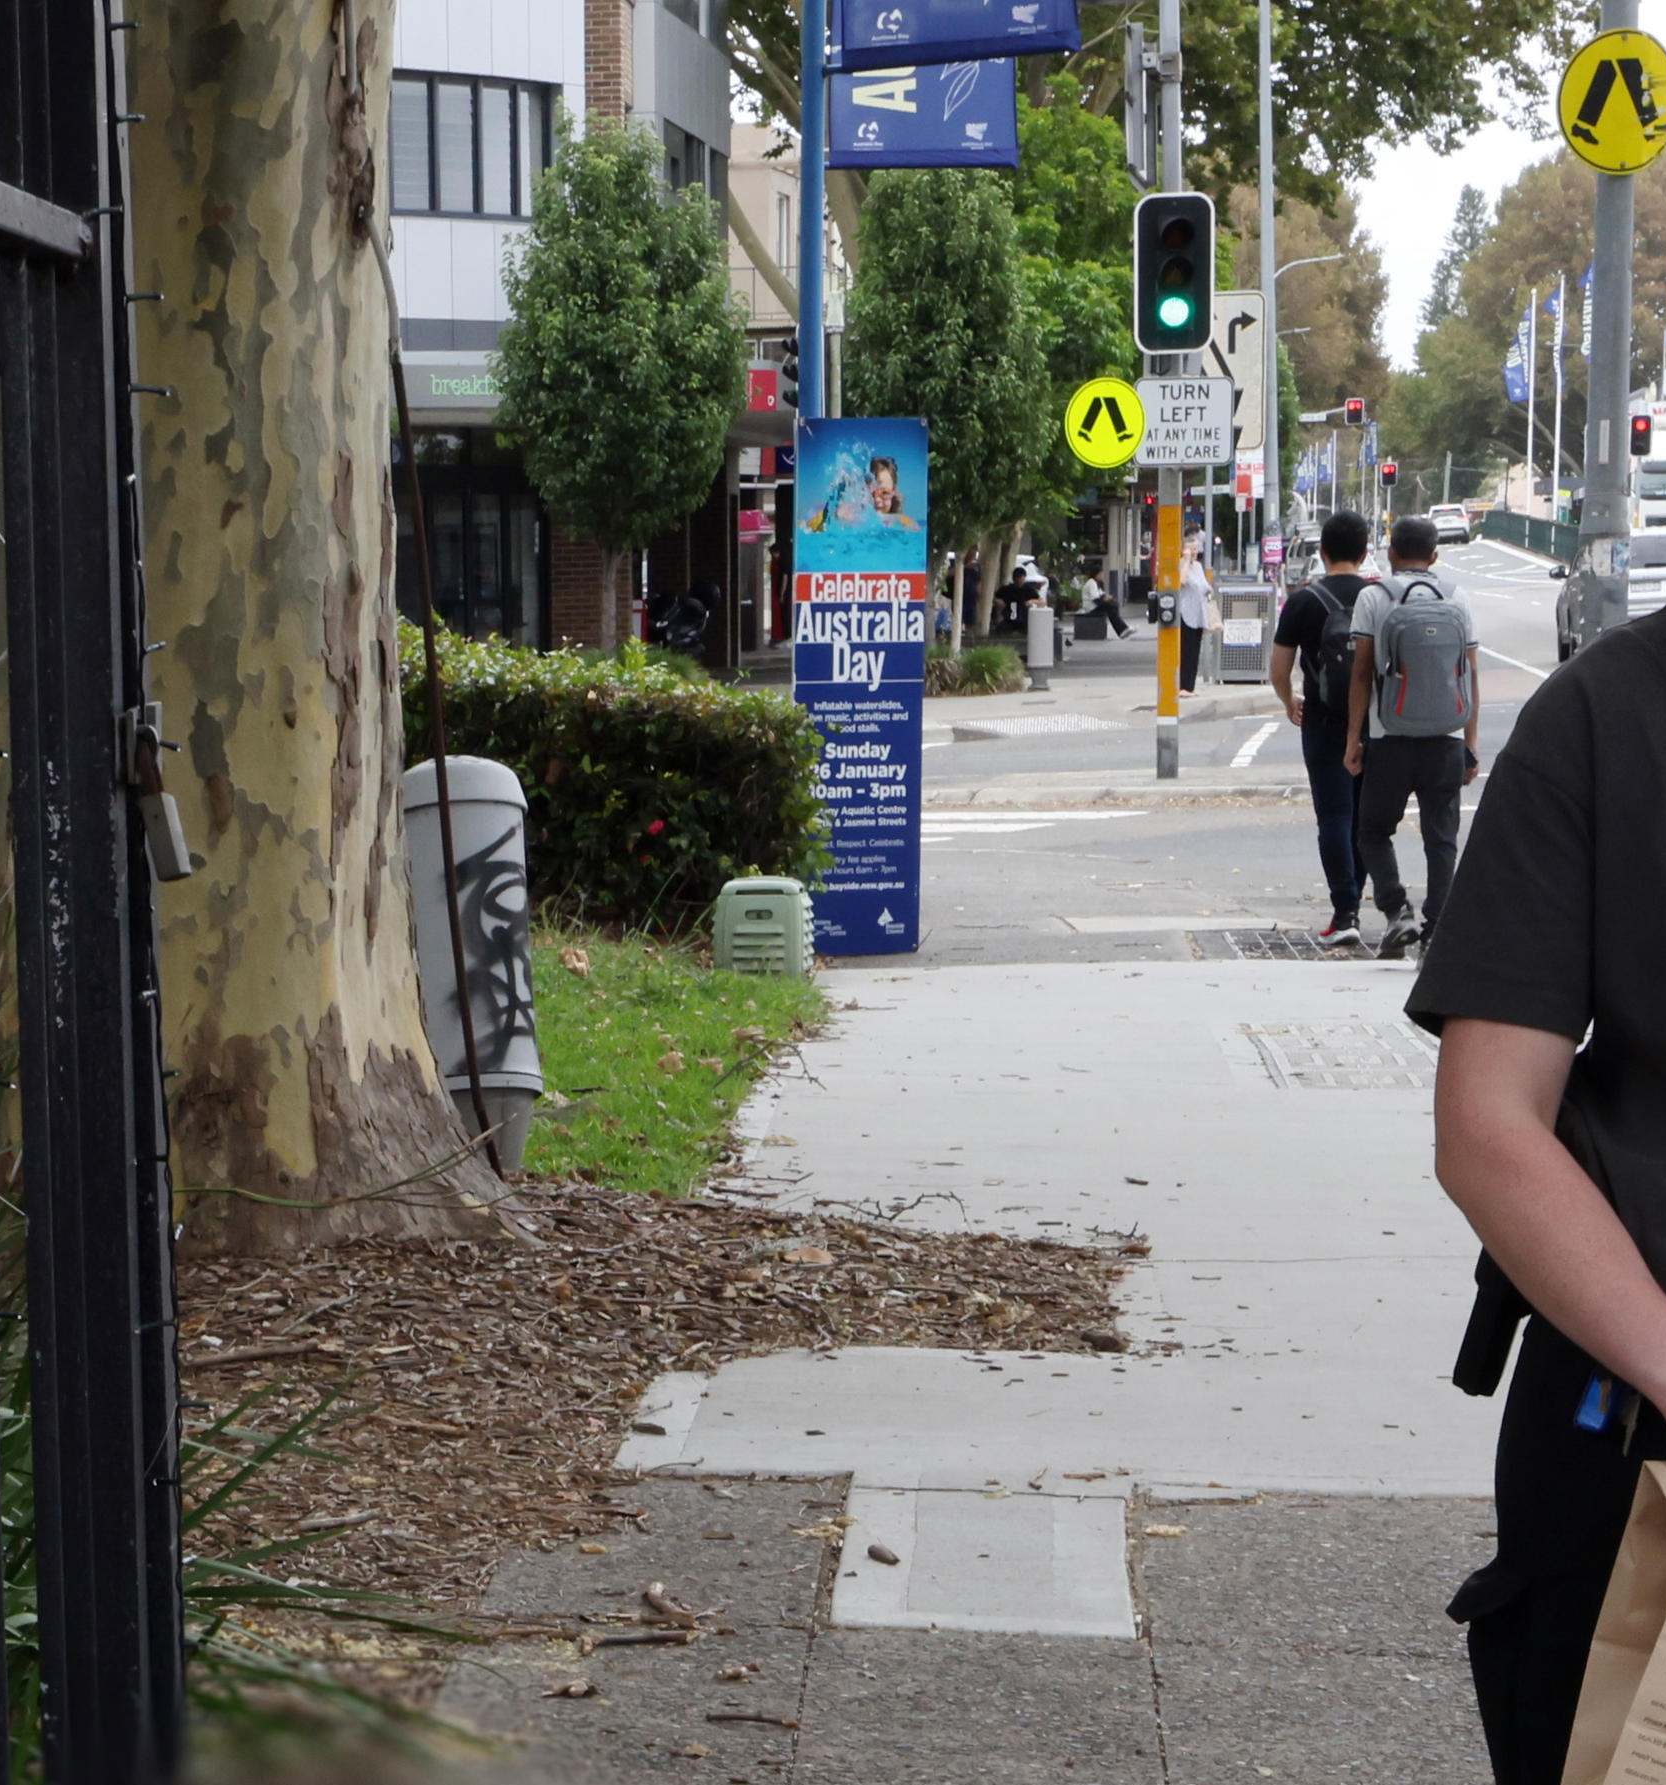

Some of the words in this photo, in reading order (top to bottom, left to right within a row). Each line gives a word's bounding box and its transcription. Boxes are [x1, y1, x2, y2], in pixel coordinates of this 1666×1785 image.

[430, 374, 501, 396] breakf
[1160, 384, 1211, 400] TURN
[1160, 406, 1207, 423] LEFT
[1146, 429, 1161, 441] AT
[1164, 428, 1187, 441] ANY
[1193, 427, 1221, 440] TIME
[1146, 446, 1177, 459] WITH
[1184, 445, 1221, 459] CARE
[810, 573, 911, 602] Celebrate
[796, 601, 925, 642] Australia
[833, 641, 885, 692] Day
[814, 701, 853, 711] Inflatable
[853, 711, 890, 721] activities
[892, 711, 909, 721] and
[839, 724, 856, 733] ood
[825, 741, 891, 761] Sunday
[835, 762, 907, 781] January
[870, 783, 907, 800] 3pm
[841, 806, 875, 816] Aquatic
[877, 805, 907, 815] Centre
[843, 818, 876, 827] Jasmine
[878, 817, 907, 826] Streets
